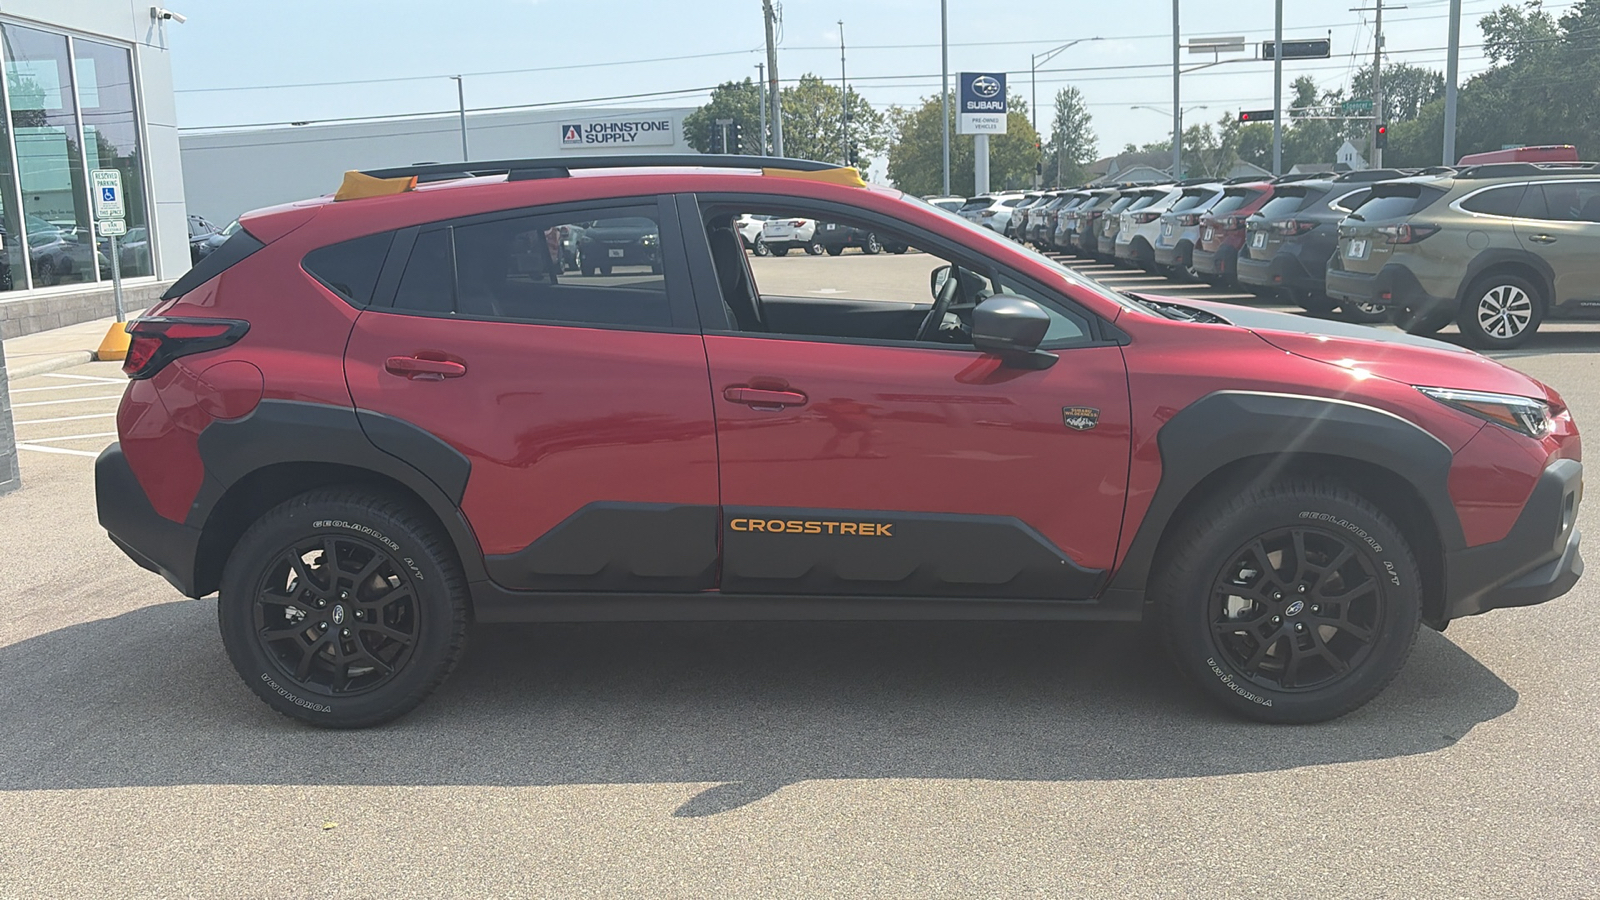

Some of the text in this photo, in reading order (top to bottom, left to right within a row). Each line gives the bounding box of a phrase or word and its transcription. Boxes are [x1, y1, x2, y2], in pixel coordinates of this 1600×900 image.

[967, 101, 1003, 109] SUBARU
[584, 120, 670, 133] JOHNSTONE
[585, 132, 638, 144] SUPPLY
[730, 518, 893, 537] CROSSTREK
[312, 520, 424, 580] GEOLANDAR A/T
[1298, 511, 1400, 586] GEOLANDAR A/T
[260, 672, 332, 713] YOKOHAMA
[1206, 657, 1273, 707] YOKOHAMA
